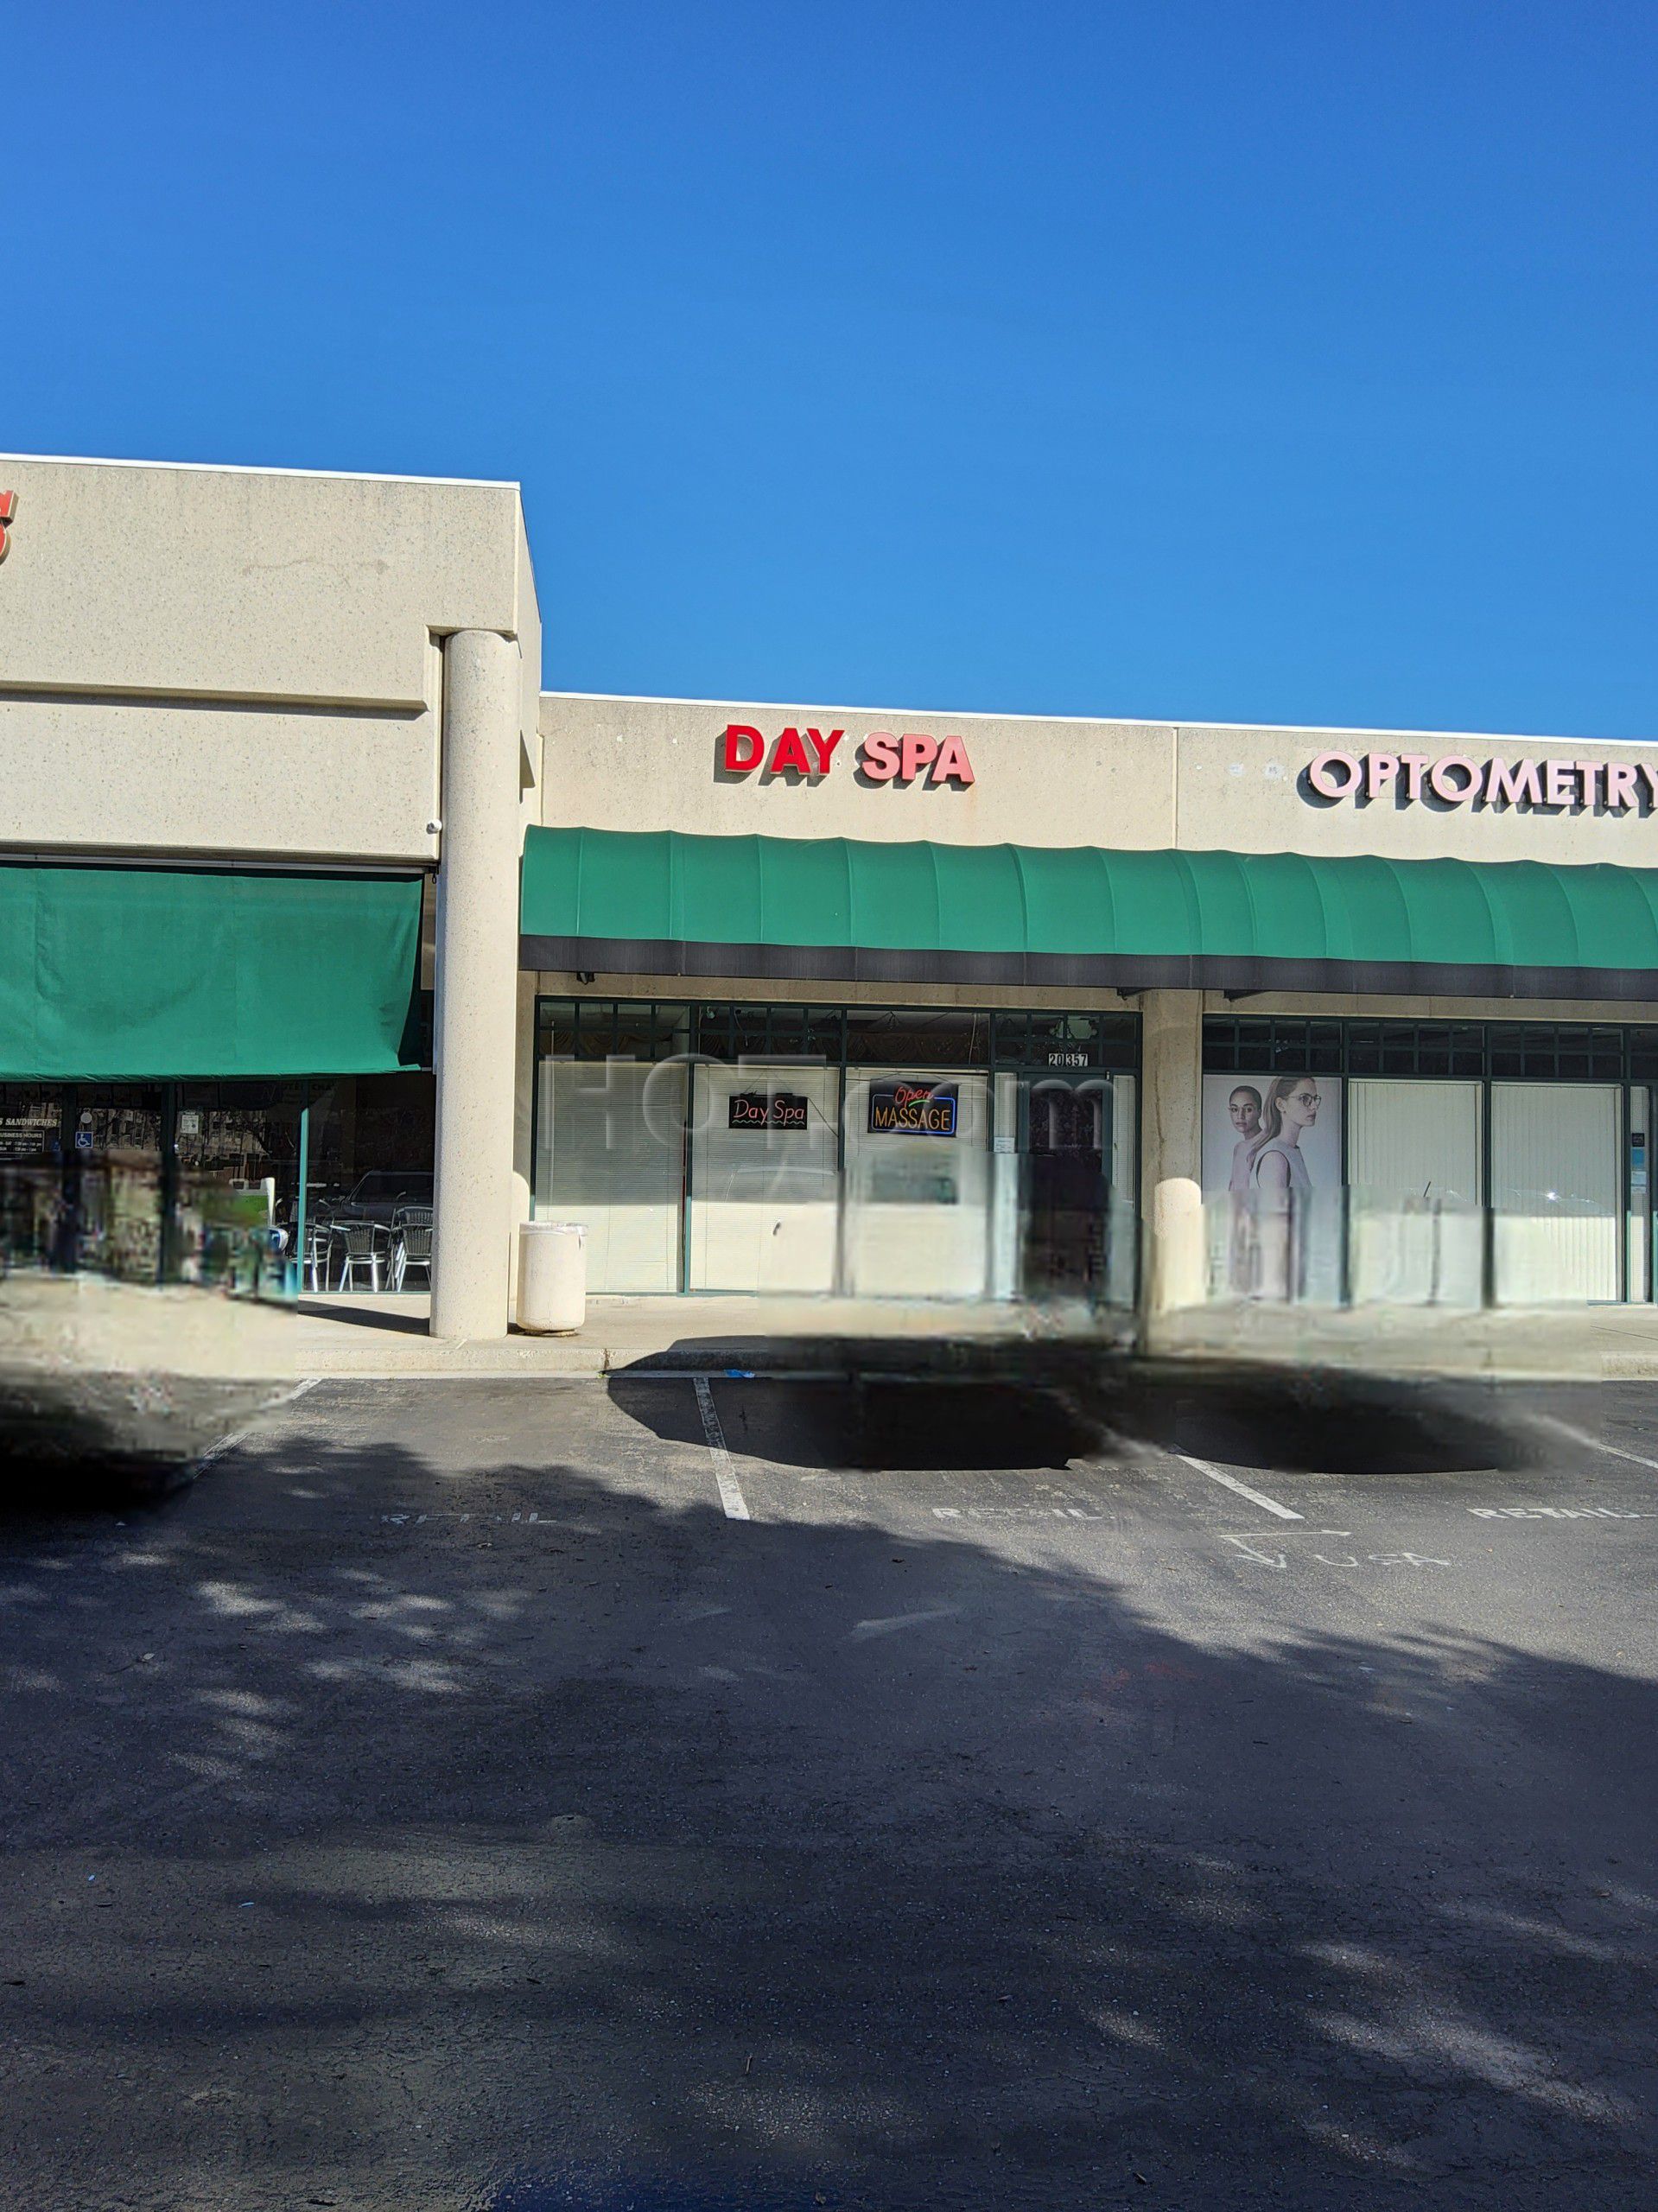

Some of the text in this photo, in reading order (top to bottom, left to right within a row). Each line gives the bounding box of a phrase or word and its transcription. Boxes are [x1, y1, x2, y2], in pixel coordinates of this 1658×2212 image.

[725, 724, 975, 784] DAY SPA
[1049, 1054, 1088, 1066] 20357
[894, 1086, 934, 1108] Open
[5, 1118, 58, 1127] SANDWICHES
[733, 1099, 805, 1127] Day Spa
[874, 1106, 951, 1131] MASSAGE
